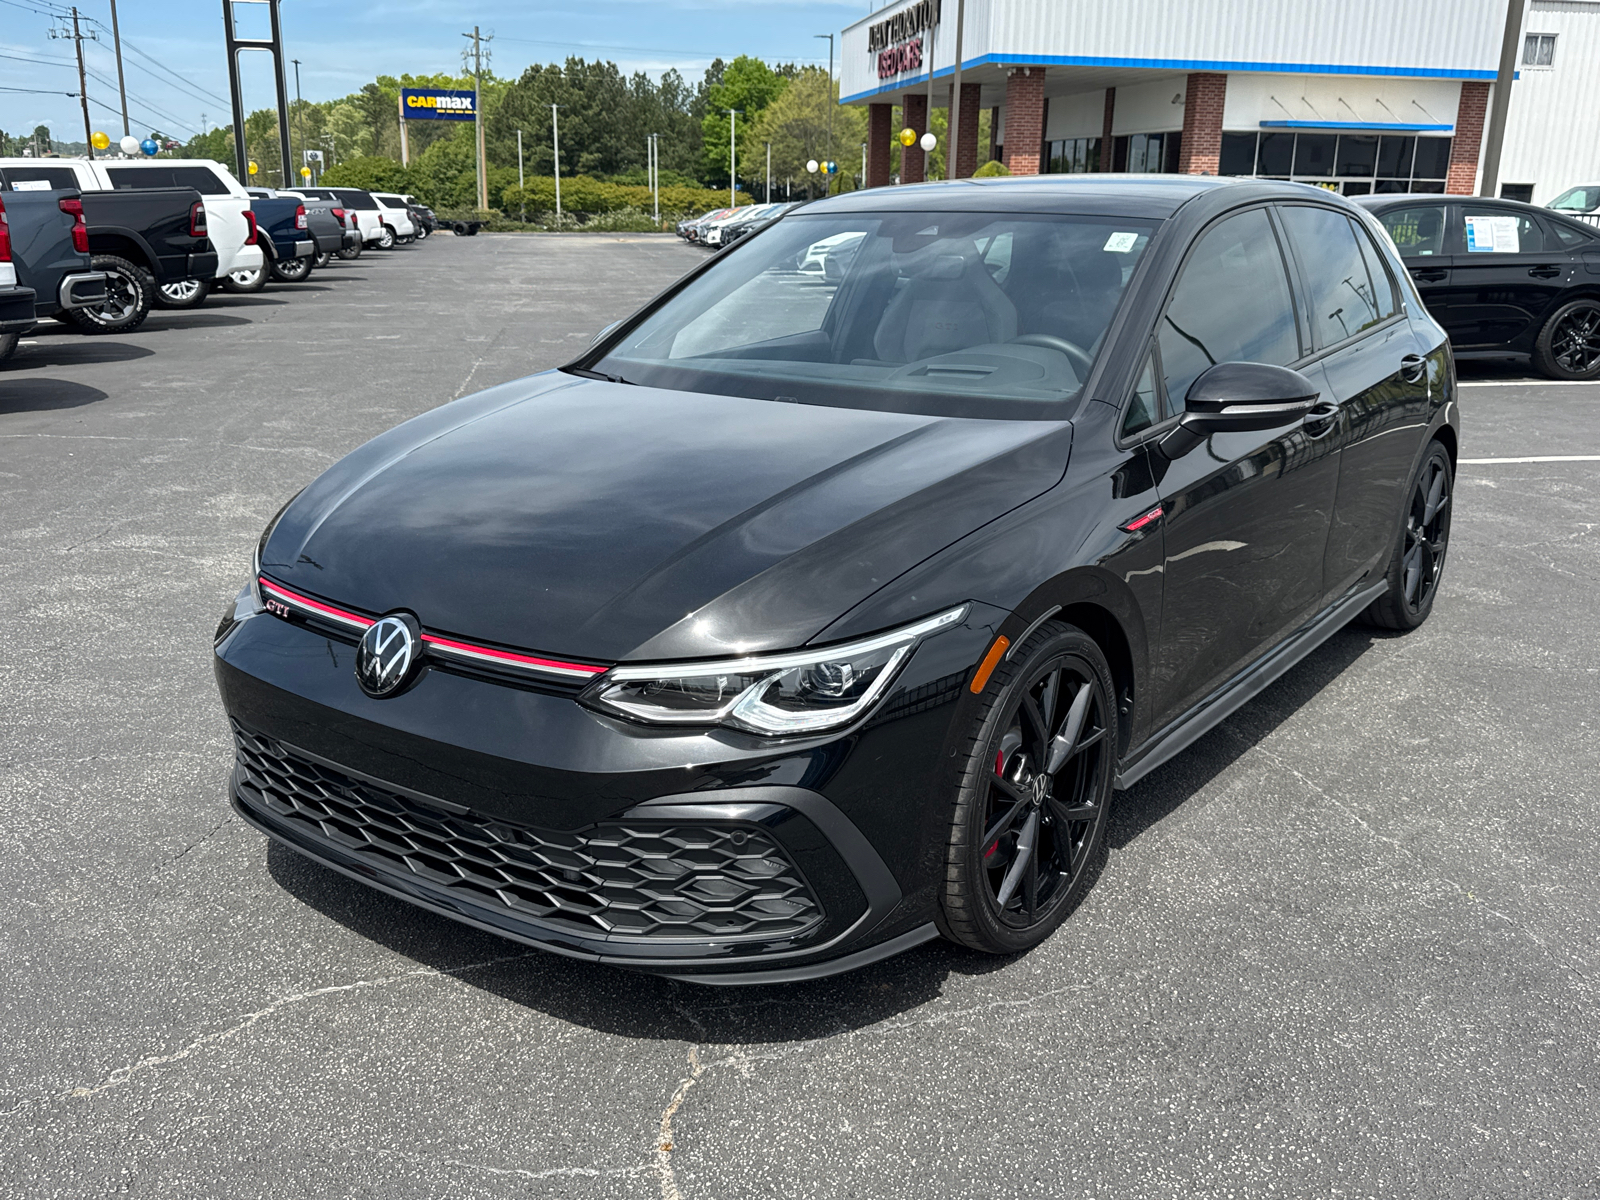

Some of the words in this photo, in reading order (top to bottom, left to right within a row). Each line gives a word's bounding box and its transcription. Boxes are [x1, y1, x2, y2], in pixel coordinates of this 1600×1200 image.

[878, 48, 898, 79] USED
[897, 38, 922, 73] CARS
[935, 322, 958, 331] GTI
[266, 599, 290, 618] GTI
